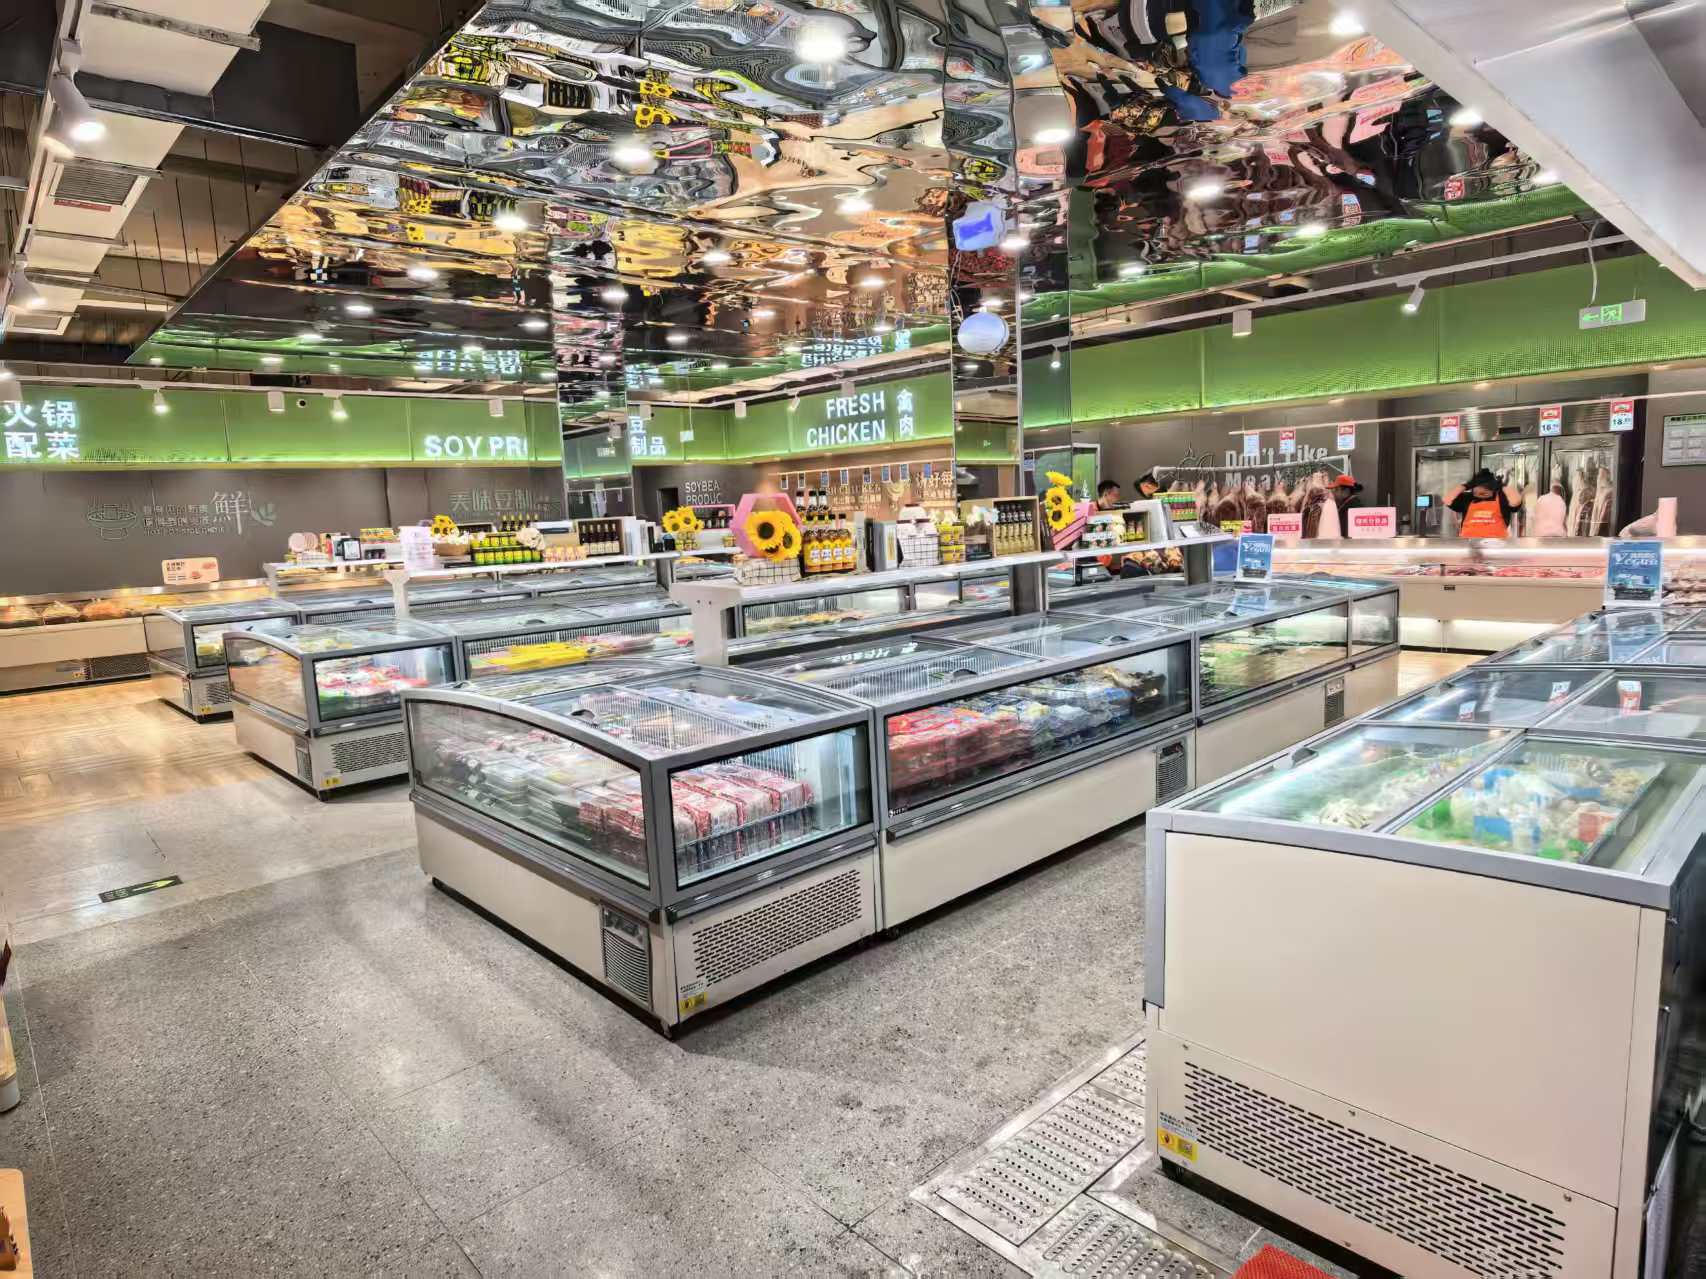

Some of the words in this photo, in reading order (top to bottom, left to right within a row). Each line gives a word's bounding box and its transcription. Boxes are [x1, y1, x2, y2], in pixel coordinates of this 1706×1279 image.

[3, 399, 77, 429] 火锅
[826, 390, 885, 419] FRESH
[3, 431, 81, 460] 配菜
[423, 434, 483, 458] SOY
[806, 419, 886, 447] CHICKEN
